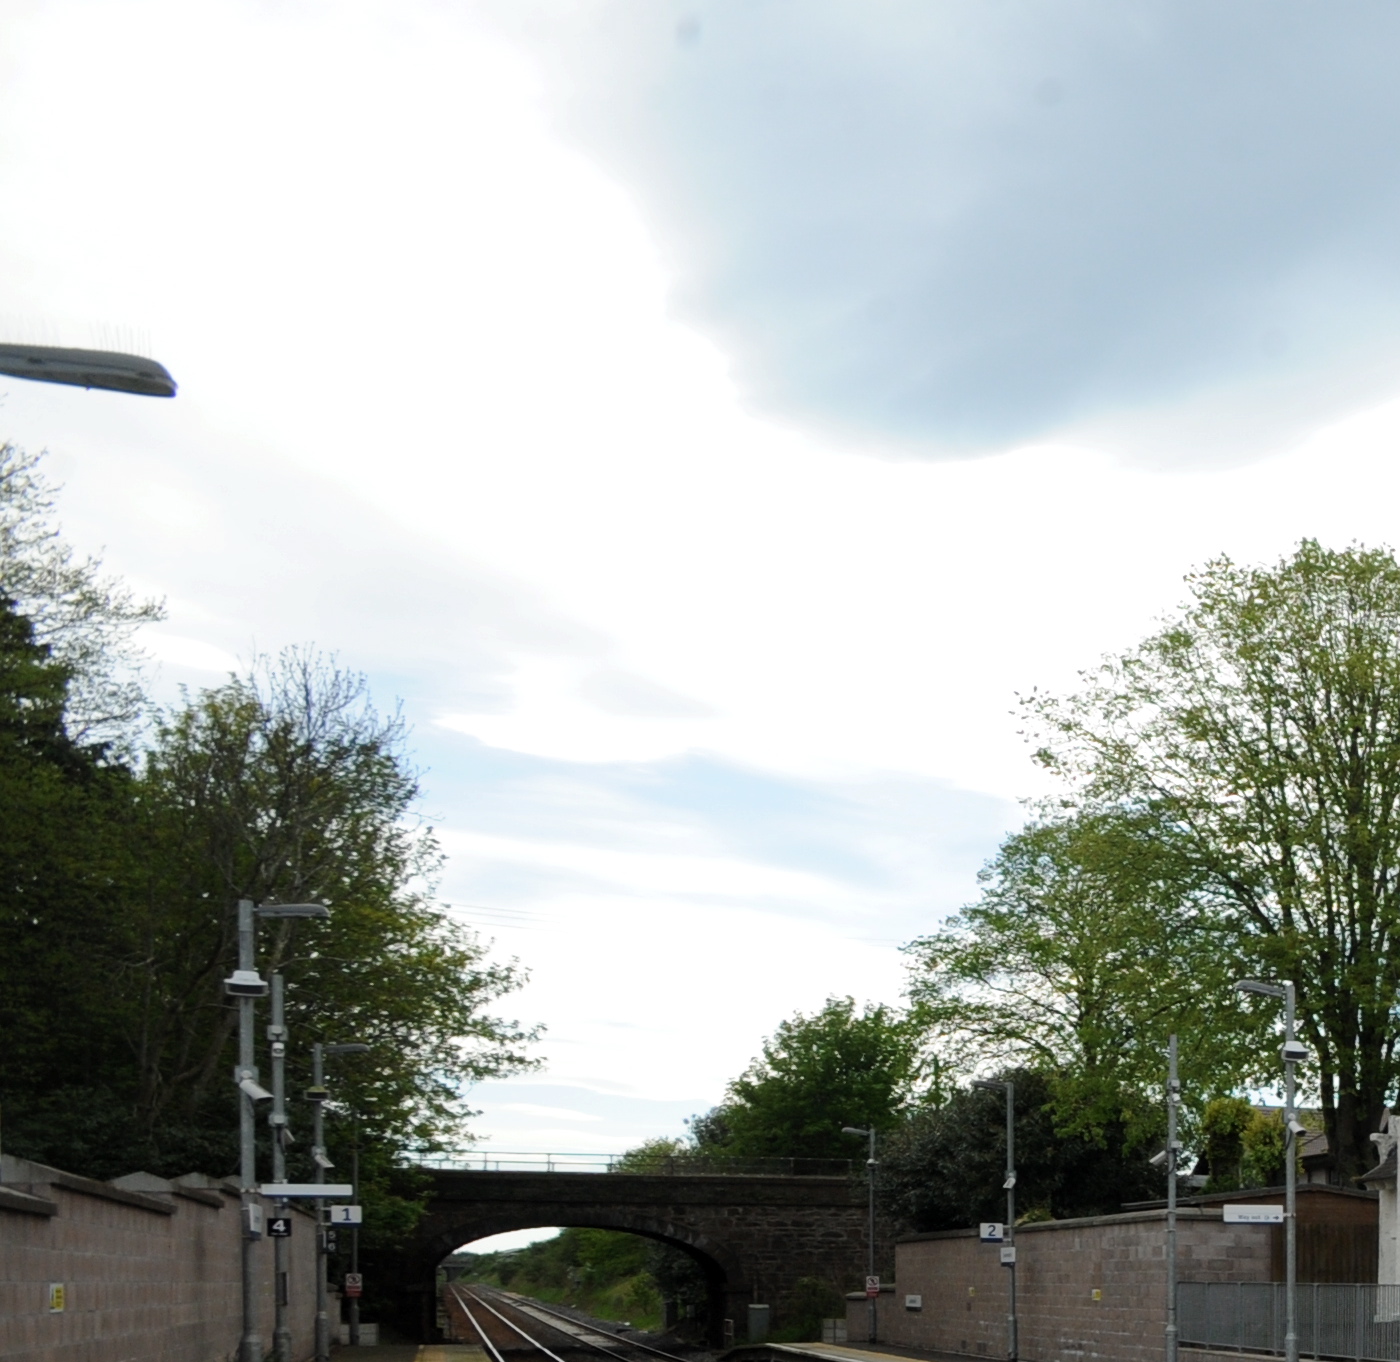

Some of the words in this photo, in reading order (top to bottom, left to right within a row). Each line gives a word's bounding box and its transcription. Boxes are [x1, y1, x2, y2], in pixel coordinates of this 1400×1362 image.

[341, 1208, 351, 1221] 1
[272, 1219, 286, 1232] 4
[987, 1224, 996, 1237] 2
[328, 1230, 336, 1239] 5
[328, 1242, 336, 1251] 6
